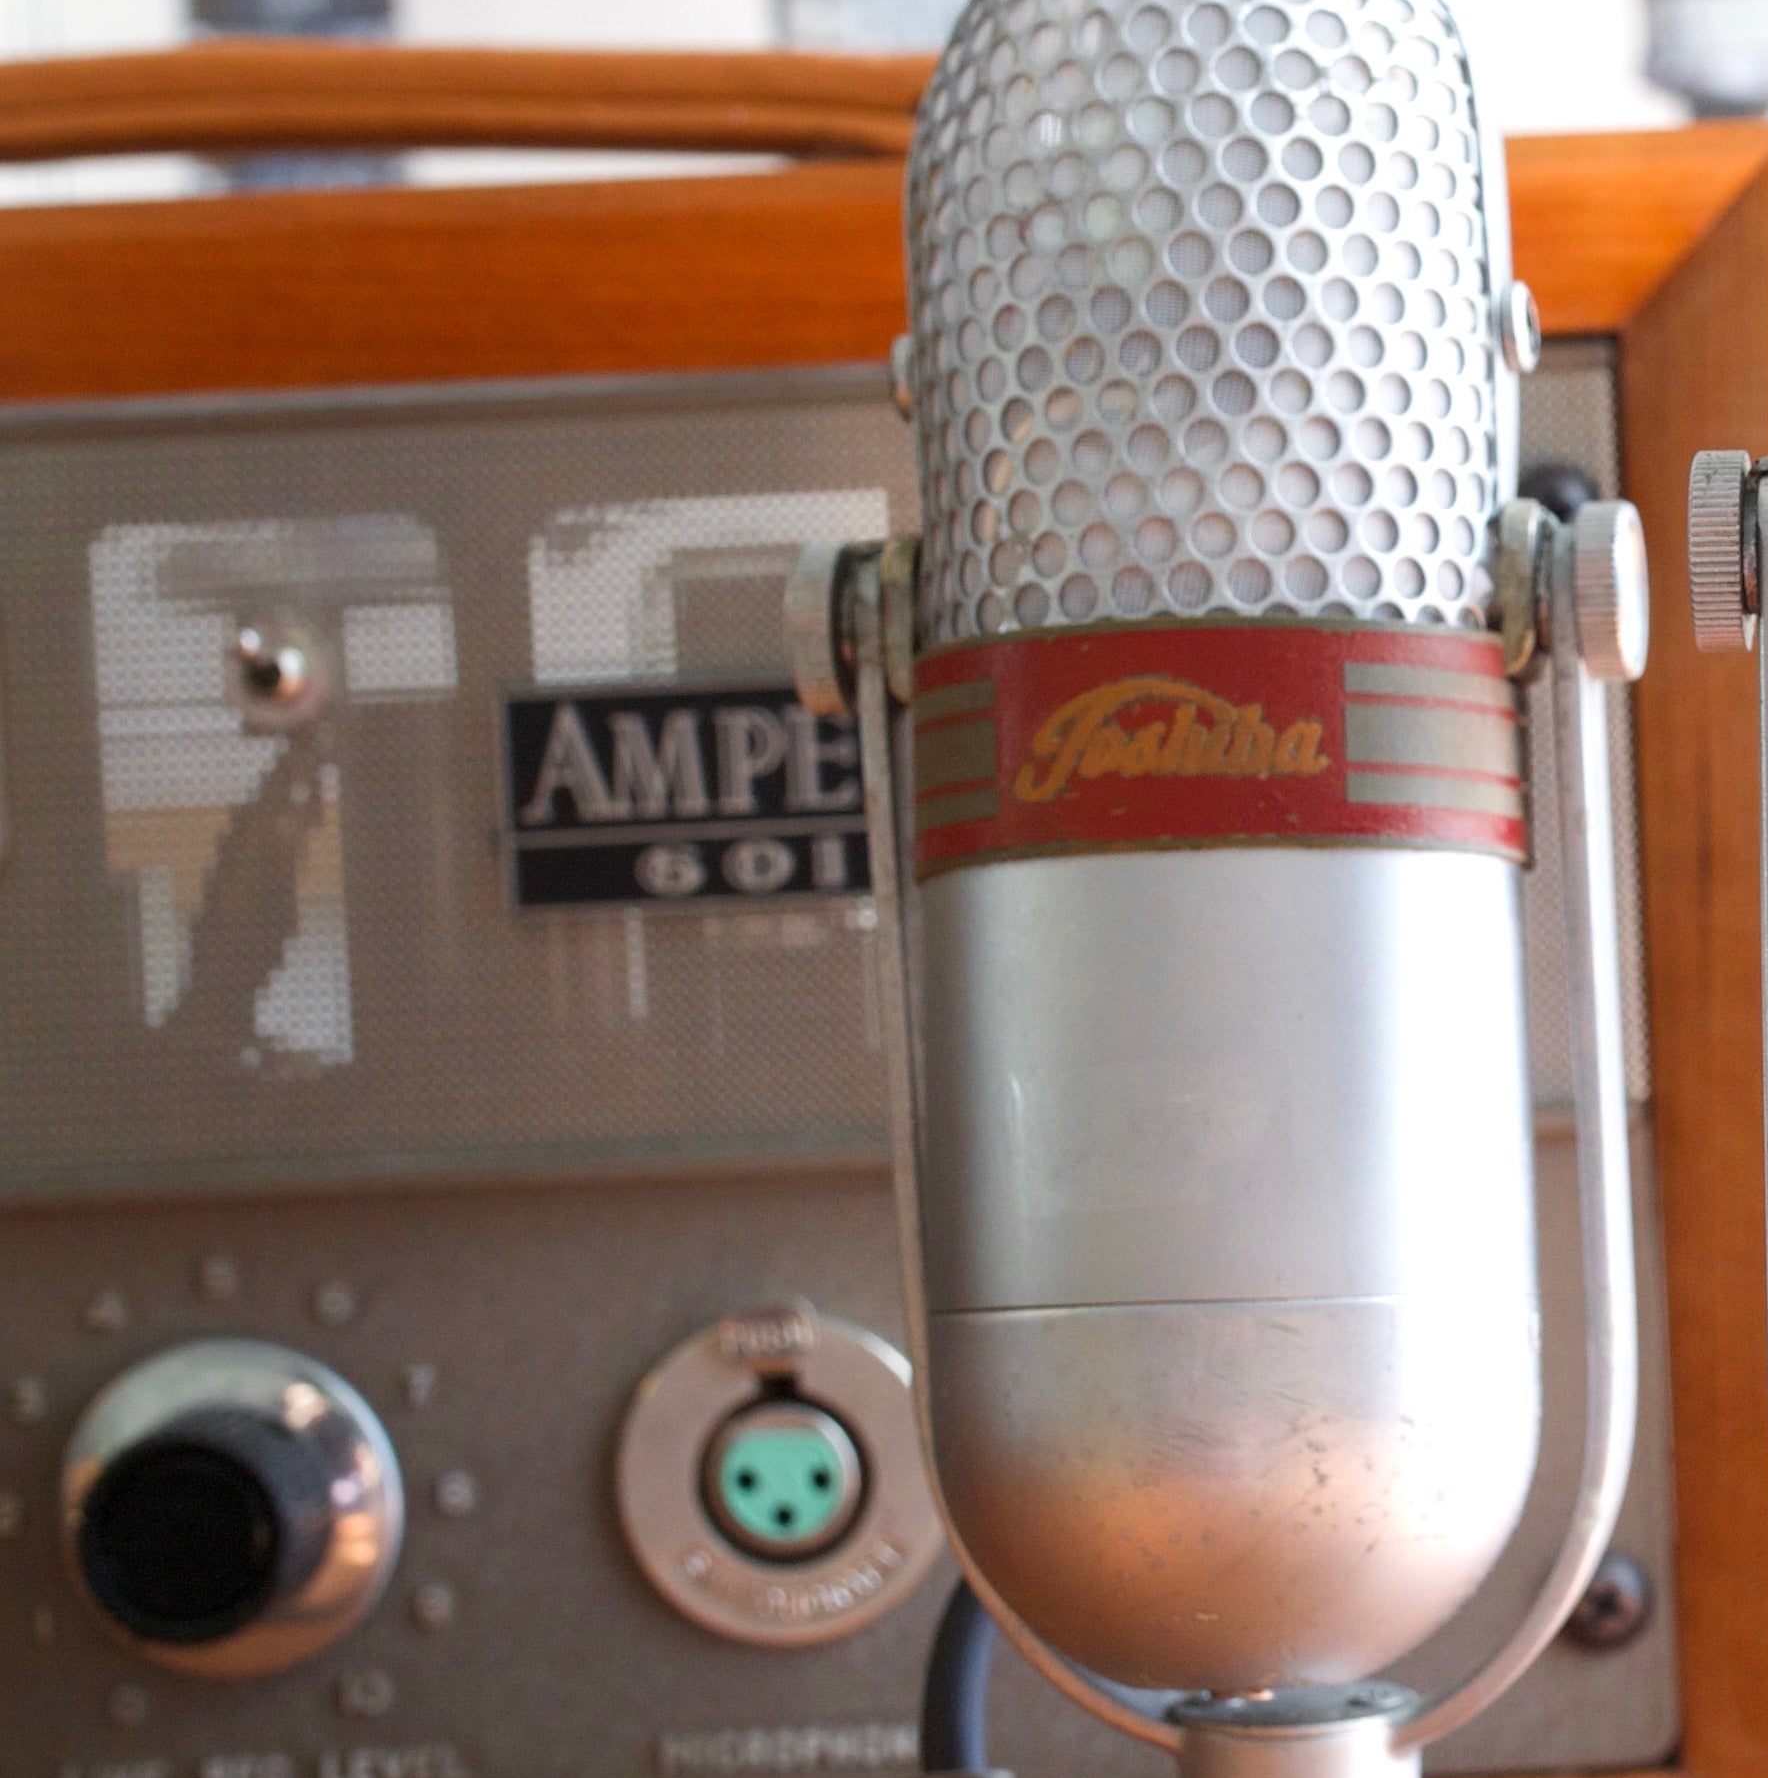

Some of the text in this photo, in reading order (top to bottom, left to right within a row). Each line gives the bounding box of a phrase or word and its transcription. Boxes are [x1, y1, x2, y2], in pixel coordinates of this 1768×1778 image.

[516, 702, 860, 825] AMPE
[1013, 672, 1331, 803] Toshiba
[634, 835, 848, 899] 601
[659, 1724, 922, 1774] MICROPHON
